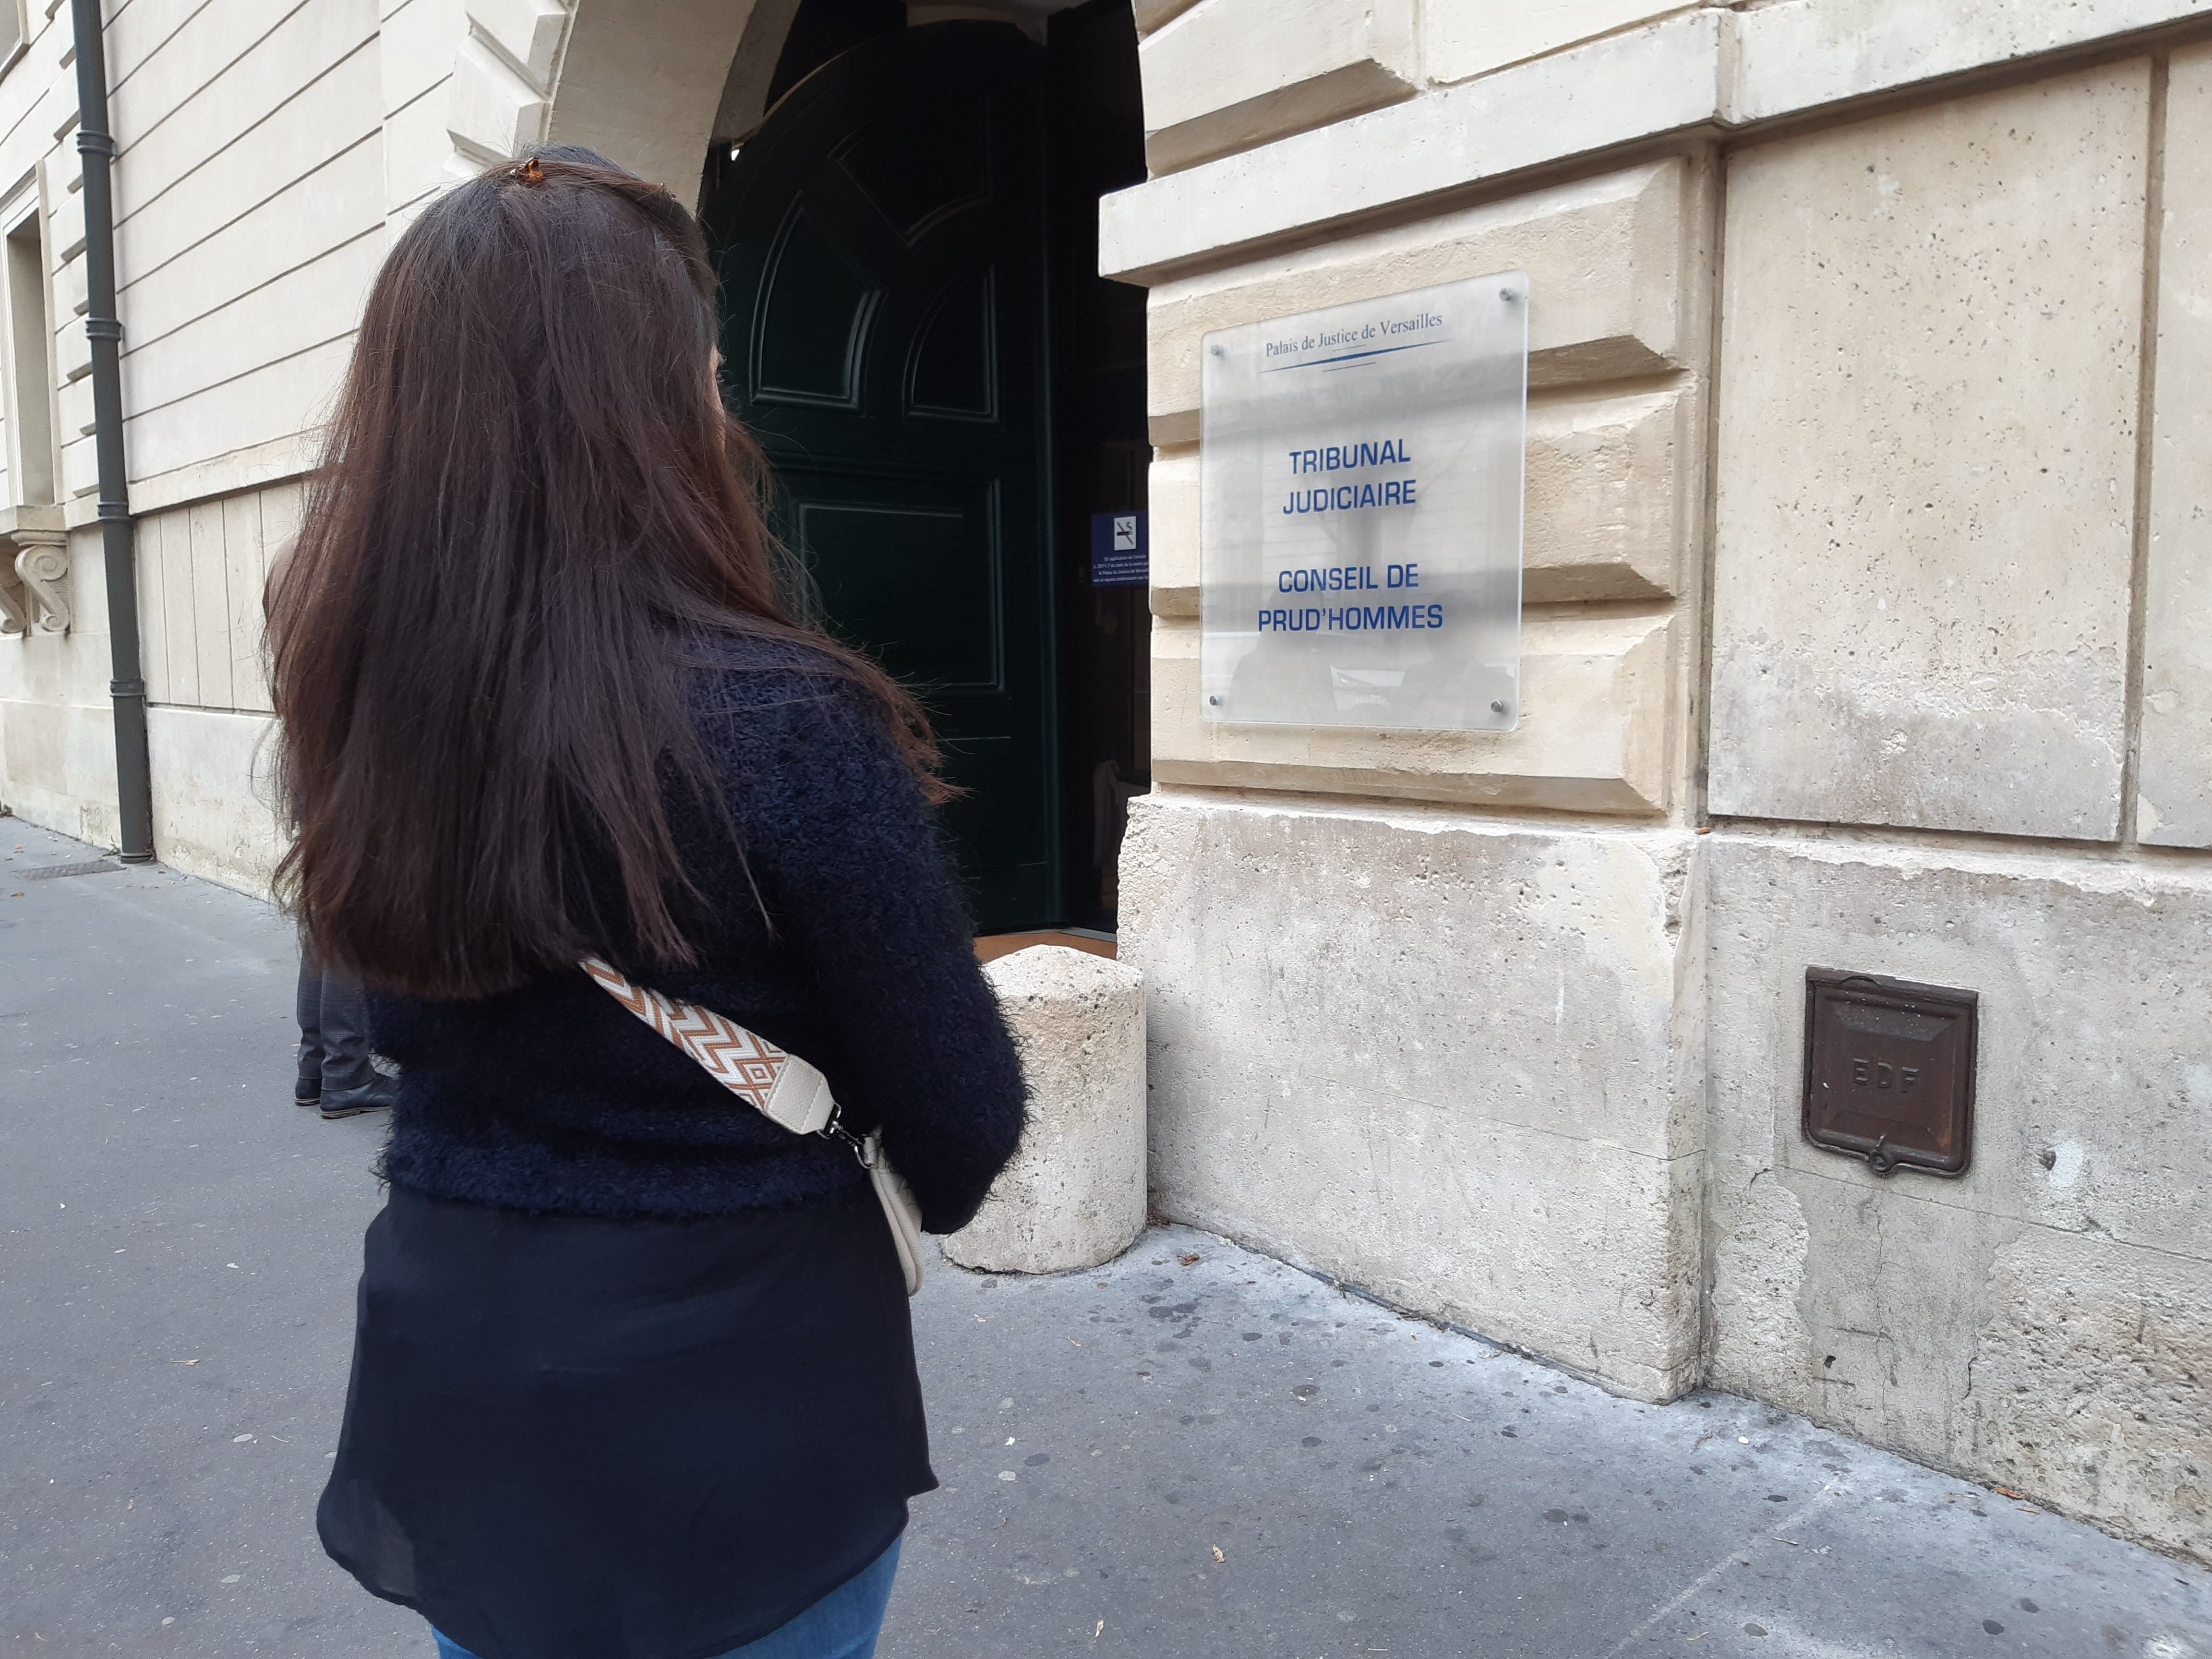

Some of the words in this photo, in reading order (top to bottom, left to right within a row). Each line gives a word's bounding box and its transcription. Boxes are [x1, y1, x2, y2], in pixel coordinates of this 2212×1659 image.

[1266, 339, 1298, 357] Palais
[1301, 335, 1315, 350] de
[1318, 329, 1358, 348] Justice
[1361, 324, 1376, 339] de
[1380, 312, 1443, 336] Versailles
[1288, 439, 1411, 475] TRIBUNAL
[1282, 479, 1417, 515] JUDICIAIRE
[1278, 566, 1378, 593] CONSEIL
[1387, 563, 1419, 589] DE
[1258, 604, 1443, 632] PRUD'HOMMES
[1852, 1057, 1920, 1094] EDF
